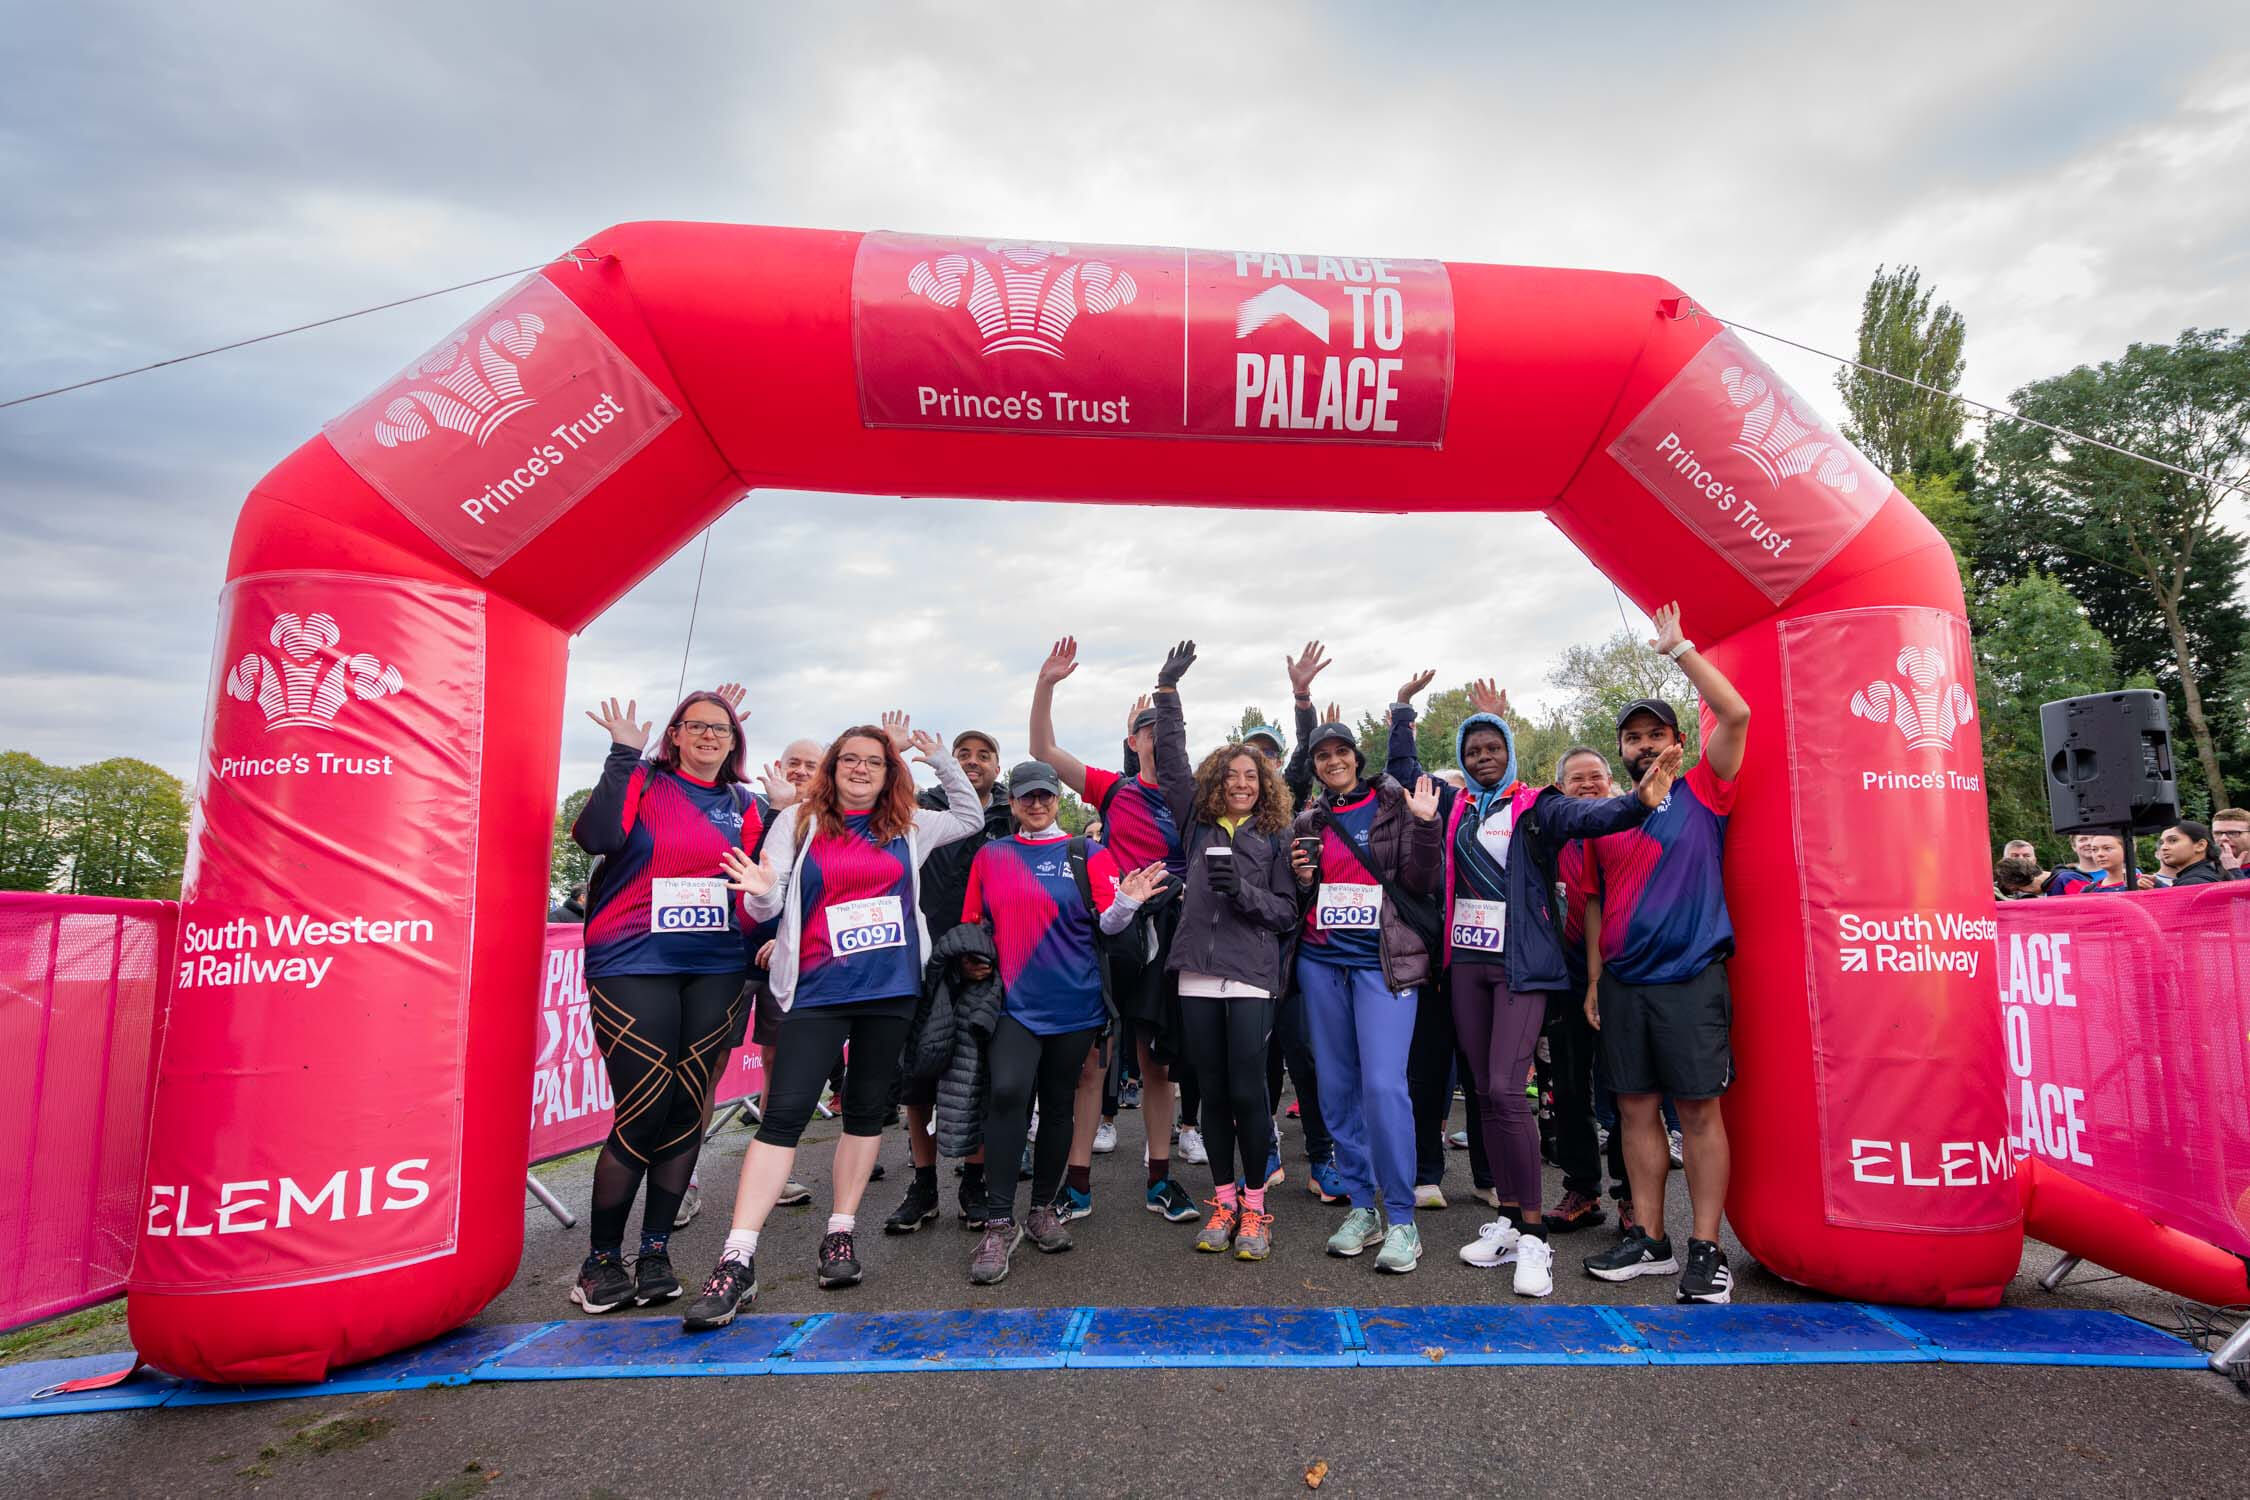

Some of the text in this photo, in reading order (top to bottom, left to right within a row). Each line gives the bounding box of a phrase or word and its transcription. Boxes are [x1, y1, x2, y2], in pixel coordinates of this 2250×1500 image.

[1343, 285, 1404, 351] TO
[918, 386, 1130, 424] Prince's Trust
[1234, 353, 1404, 432] PALACE
[460, 392, 624, 525] Prince's Trust
[1655, 432, 1792, 558] Prince's Trust
[220, 752, 394, 779] Prince's Trust
[1862, 770, 1980, 792] Prince's Trust
[1485, 829, 1513, 838] worldp
[184, 914, 434, 954] South Western
[663, 907, 722, 928] 6031
[1323, 906, 1373, 925] 6503
[1839, 912, 1998, 942] South Wester
[841, 923, 897, 950] 6097
[1453, 926, 1497, 947] 6647
[197, 952, 334, 989] Railway
[543, 947, 591, 1008] PAL
[1876, 944, 1979, 978] Railway
[2001, 932, 2077, 1007] ACE
[562, 1002, 597, 1062] TO
[530, 1056, 616, 1131] PALAC
[2011, 1079, 2094, 1167] ACE
[1847, 1136, 2016, 1187] ELEMI
[146, 1158, 430, 1237] ELEMIS
